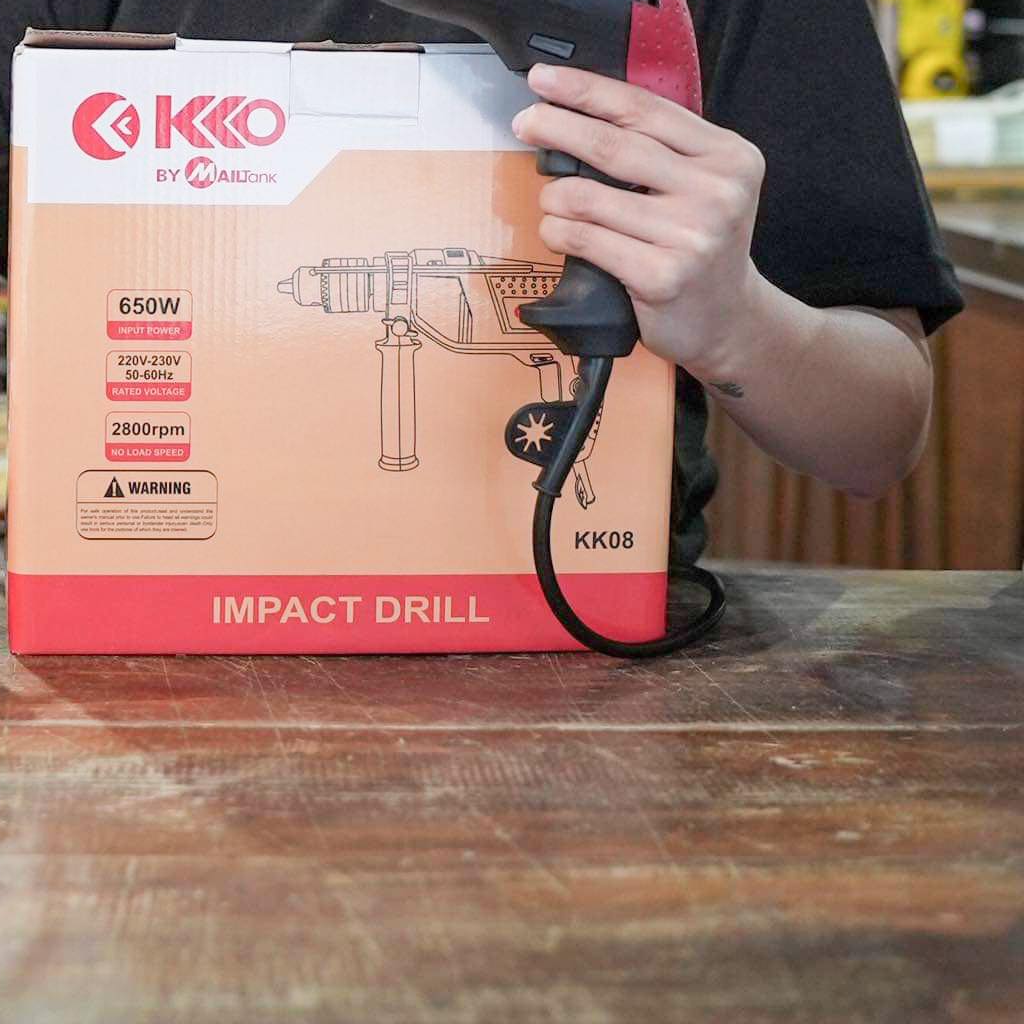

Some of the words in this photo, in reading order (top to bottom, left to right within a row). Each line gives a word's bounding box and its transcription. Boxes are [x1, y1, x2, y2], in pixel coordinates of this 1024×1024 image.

[155, 95, 286, 149] KKO
[156, 169, 180, 182] BY
[119, 297, 180, 315] 650W
[118, 326, 144, 335] INPUT
[147, 326, 181, 335] POWER
[118, 355, 182, 367] 220V-230V
[125, 369, 174, 381] 50-60Hz
[112, 387, 142, 396] RATED
[144, 387, 185, 396] VOLTAGE
[111, 422, 185, 439] 2800rpm
[111, 448, 125, 457] NO
[127, 448, 152, 457] LOAD
[154, 448, 184, 457] SPEED
[128, 481, 191, 495] WARNING
[575, 532, 634, 549] KK08
[212, 596, 362, 624] IMPACT
[376, 595, 490, 623] DRILL
